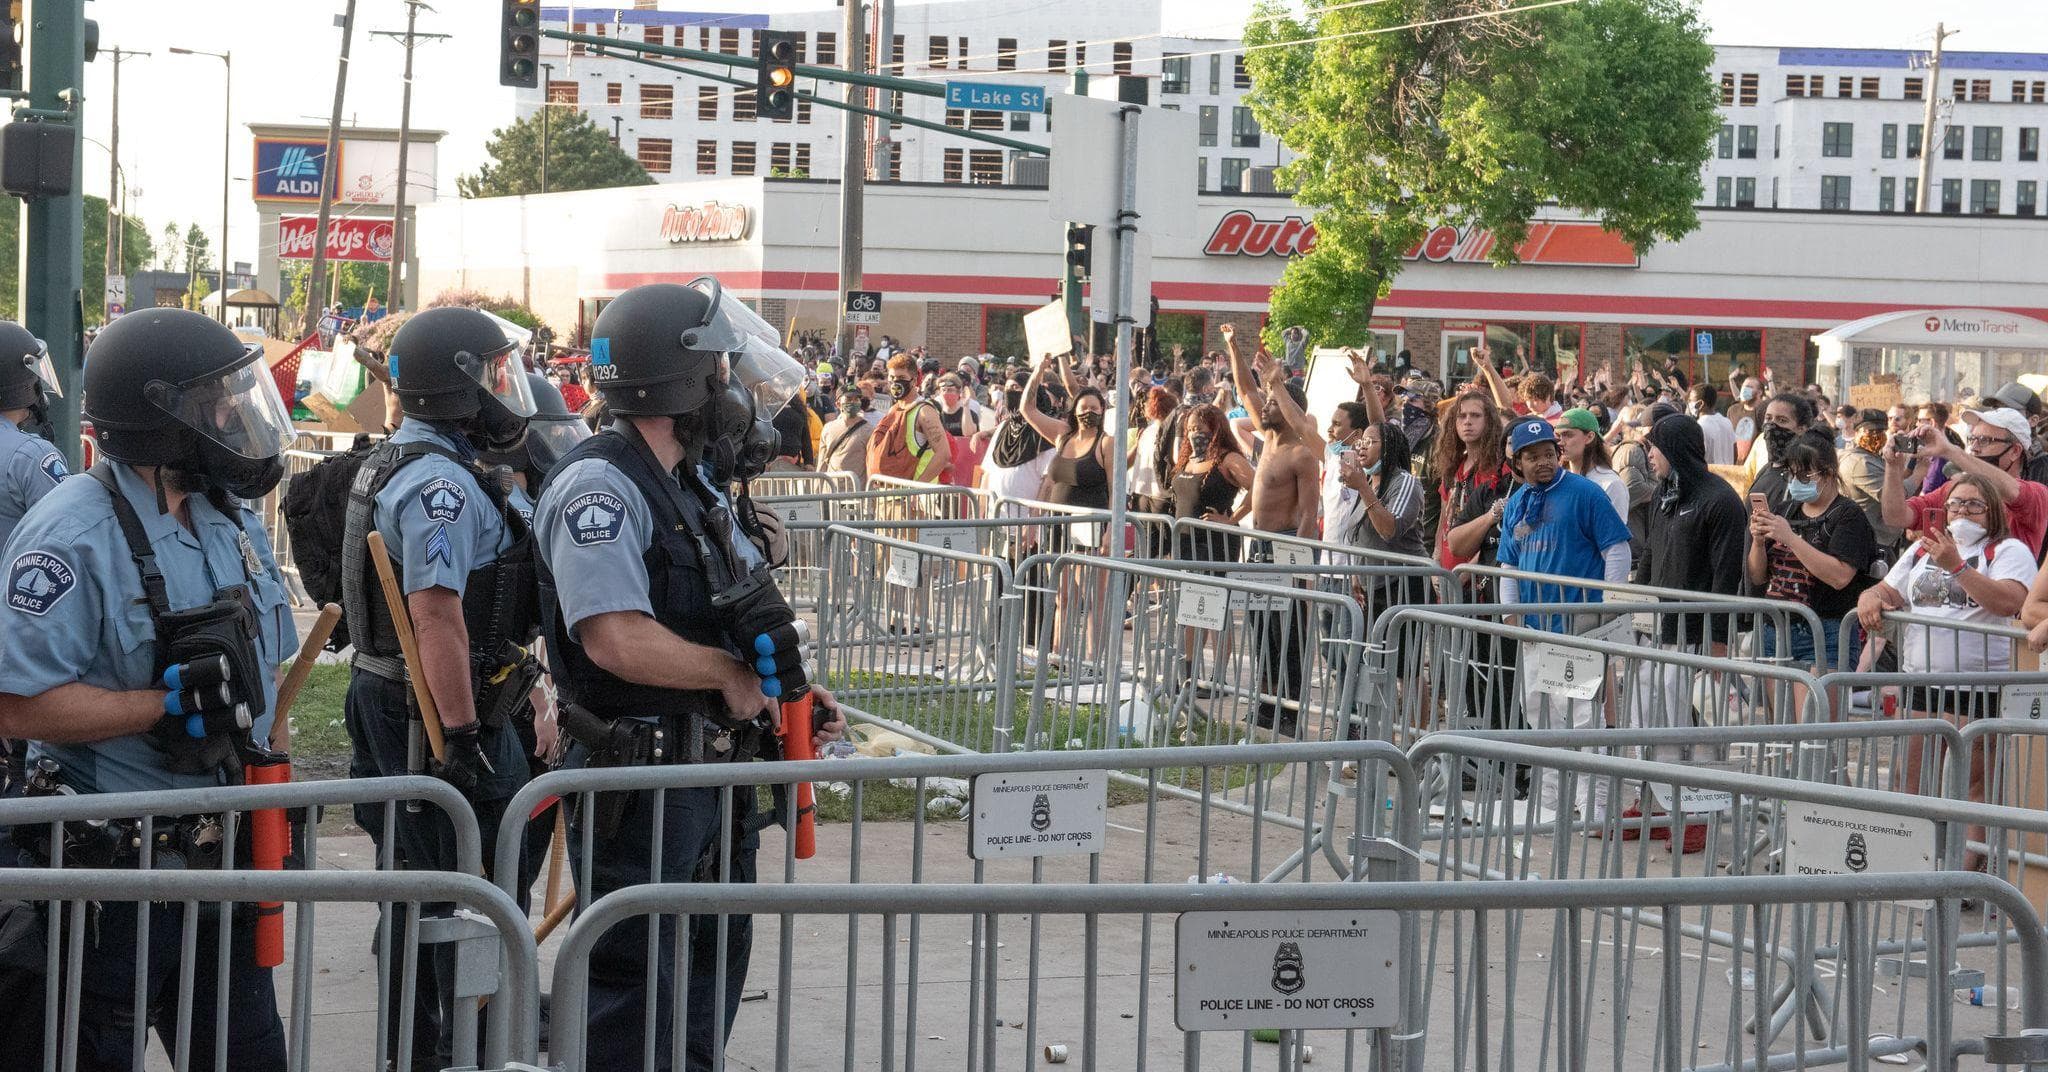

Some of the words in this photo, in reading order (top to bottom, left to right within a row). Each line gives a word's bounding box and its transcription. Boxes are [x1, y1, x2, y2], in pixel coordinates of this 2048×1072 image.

[952, 88, 961, 101] E
[971, 89, 1011, 104] Lake
[1021, 92, 1039, 106] St
[276, 180, 318, 194] ALDI
[279, 222, 364, 256] Wedy's
[847, 313, 859, 321] BIKE
[865, 314, 879, 322] LANE
[422, 480, 464, 499] MINNEAPOLIS
[566, 495, 623, 516] MINNEAPOLIS
[433, 510, 454, 519] POLICE
[581, 530, 611, 541] POLICE
[16, 555, 72, 584] MINNEAPOLIS
[12, 594, 43, 610] POLICE
[993, 785, 1030, 793] MINNEAPOLIS
[1032, 784, 1052, 792] POLICE
[1053, 783, 1089, 791] DEPARTMENT
[1803, 815, 1844, 828] MINNEAPOLIS
[1845, 822, 1868, 832] POLICE
[1870, 825, 1912, 838] DEPARTMENT
[987, 836, 1013, 845] POLICE
[1016, 835, 1031, 843] LINE
[1038, 834, 1048, 842] DO
[1051, 833, 1066, 841] NOT
[1068, 832, 1092, 840] CROSS
[1208, 930, 1269, 939] MINNEAPOLIS
[1272, 930, 1304, 939] POLICE
[1308, 929, 1368, 938] DEPARTMENT
[1200, 1000, 1243, 1010] POLICE
[1247, 1000, 1273, 1010] LINE
[1284, 1000, 1301, 1009] DO
[1306, 999, 1330, 1009] NOT
[1333, 998, 1375, 1009] CROSS
